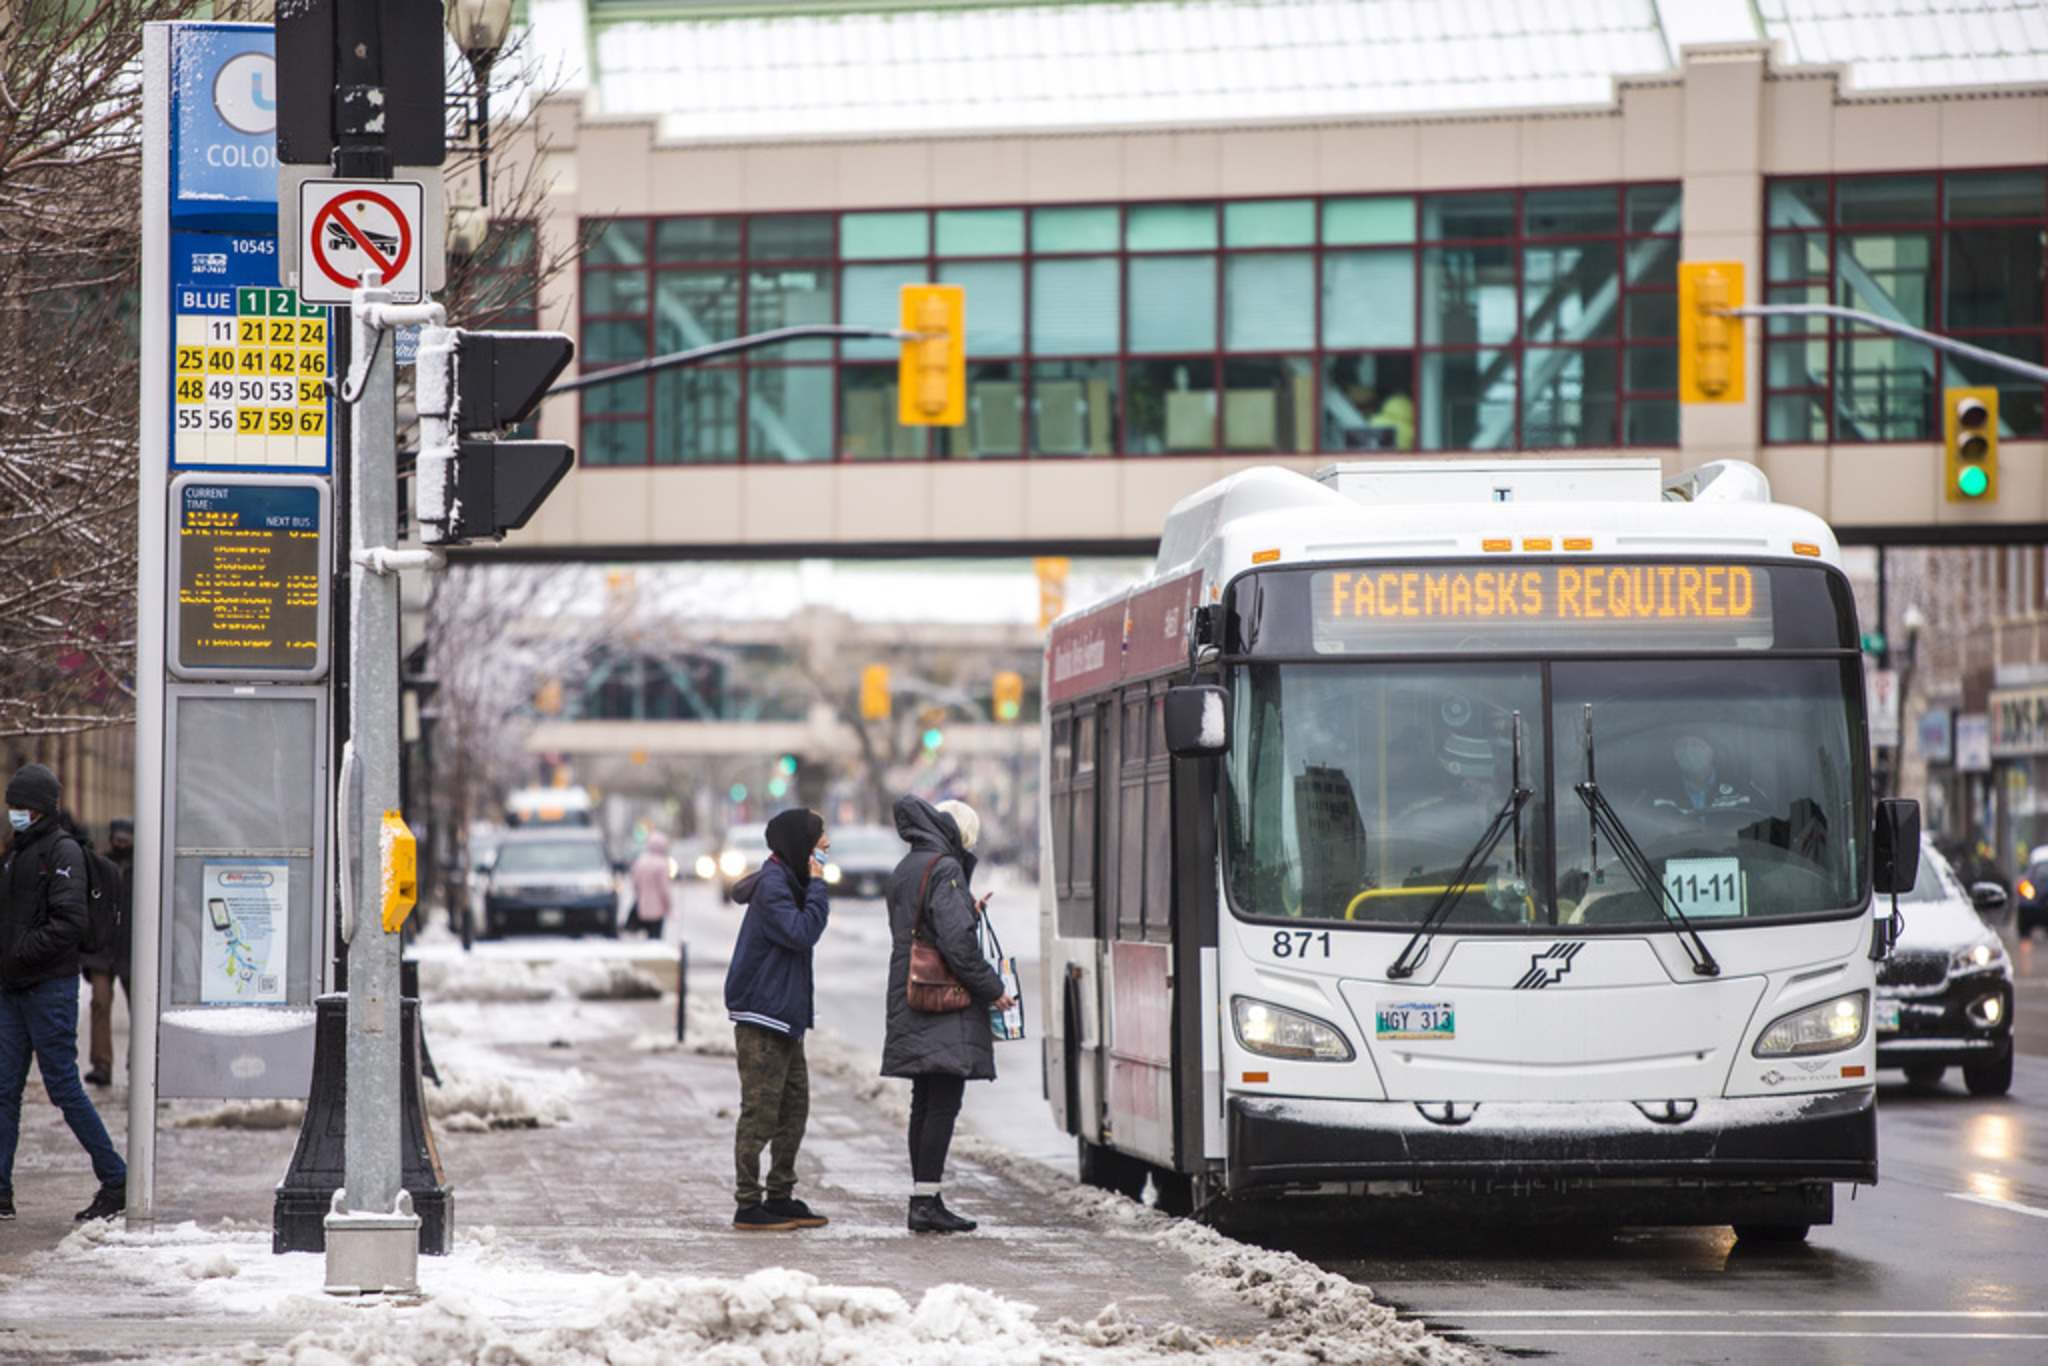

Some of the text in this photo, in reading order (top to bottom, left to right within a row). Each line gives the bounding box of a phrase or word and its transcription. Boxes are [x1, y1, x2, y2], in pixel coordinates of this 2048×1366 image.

[207, 144, 276, 168] COLO
[231, 240, 275, 255] 10545
[183, 291, 231, 309] BLUE
[246, 294, 257, 312] 1
[276, 295, 289, 313] 2
[212, 321, 324, 343] 11 21 22 24
[179, 350, 325, 373] 25 40 41 42 46
[178, 380, 325, 401] 48 49 50 53 54
[178, 410, 324, 431] 55 56 57 59 67
[185, 488, 229, 499] CURRENT
[186, 499, 213, 511] TIME:
[266, 516, 291, 528] NEXT
[1331, 566, 1754, 618] FACEMASKS REQUIRED
[1671, 872, 1735, 903] 11-11
[1273, 930, 1330, 959] 871
[1380, 1010, 1452, 1031] HGY 313
